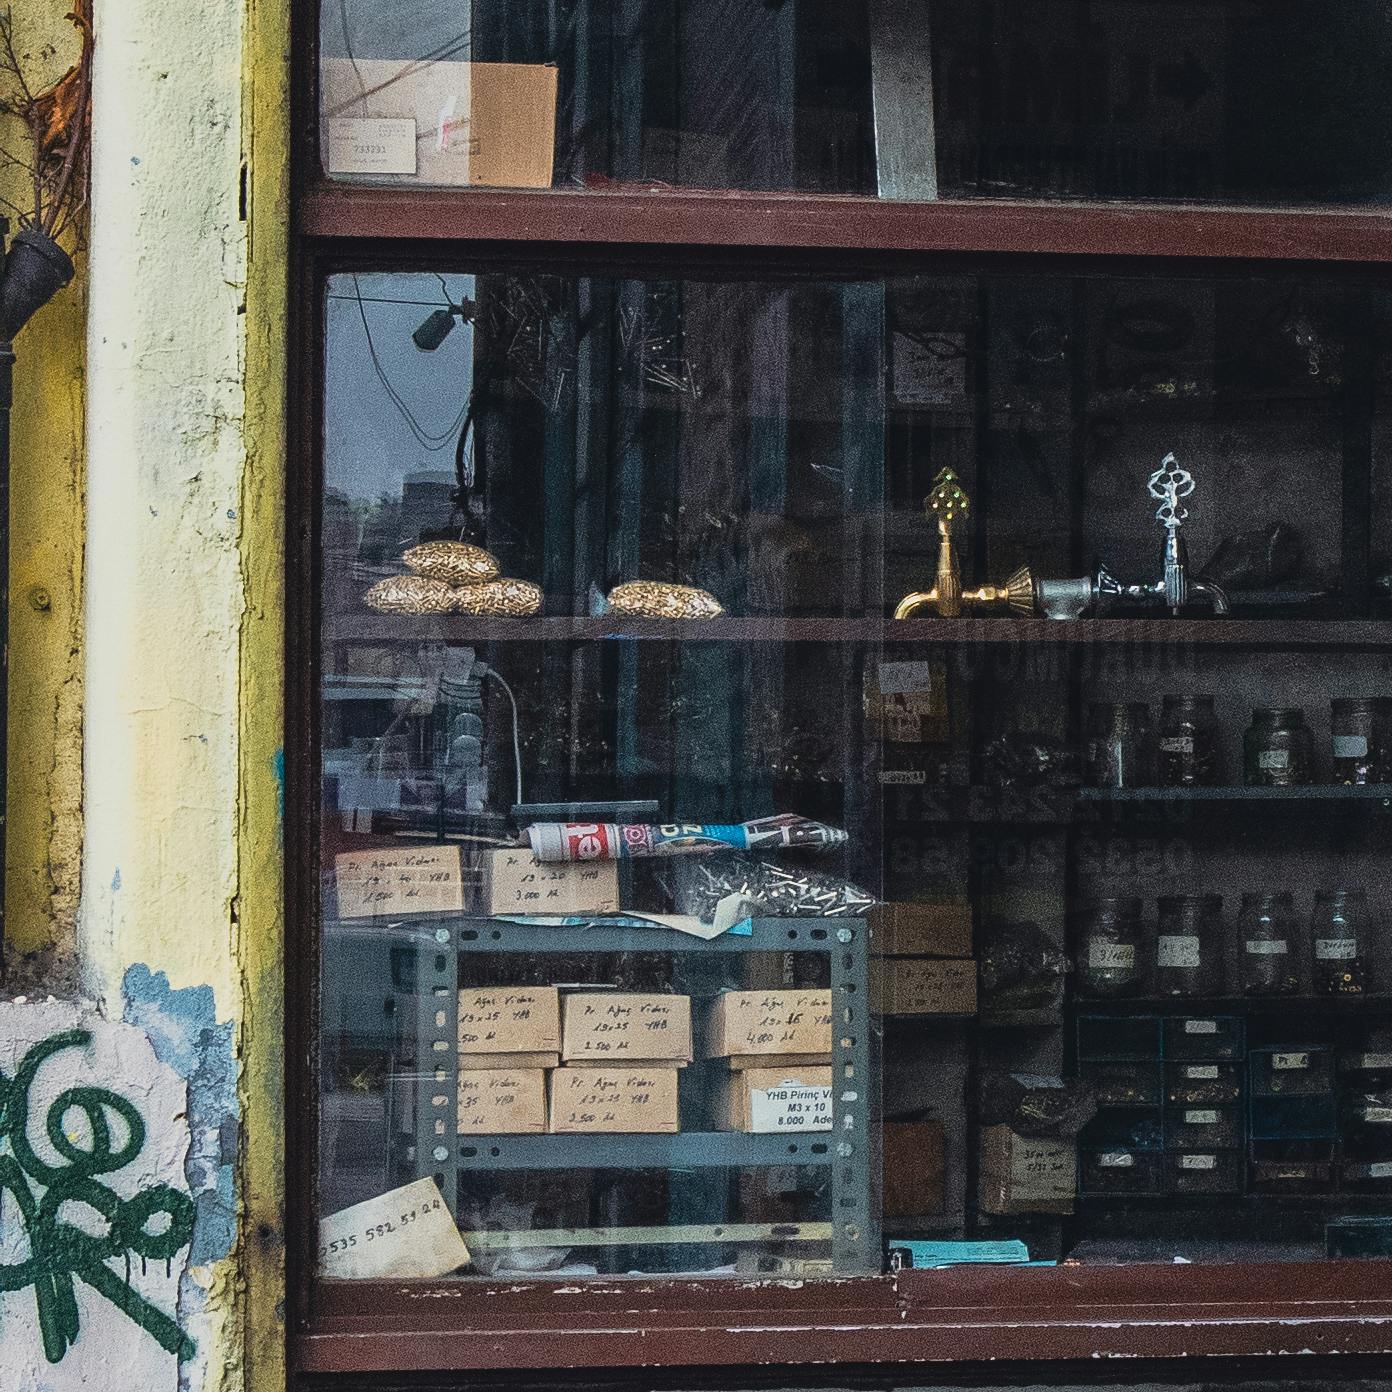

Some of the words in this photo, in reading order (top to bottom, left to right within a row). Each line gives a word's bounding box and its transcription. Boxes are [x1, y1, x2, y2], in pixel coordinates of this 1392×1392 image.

[766, 1090, 788, 1101] YHB
[790, 1090, 820, 1101] Pirinç
[787, 1103, 802, 1113] M3
[814, 1102, 826, 1112] 10
[777, 1116, 805, 1126] 8.000
[365, 1222, 396, 1242] 582
